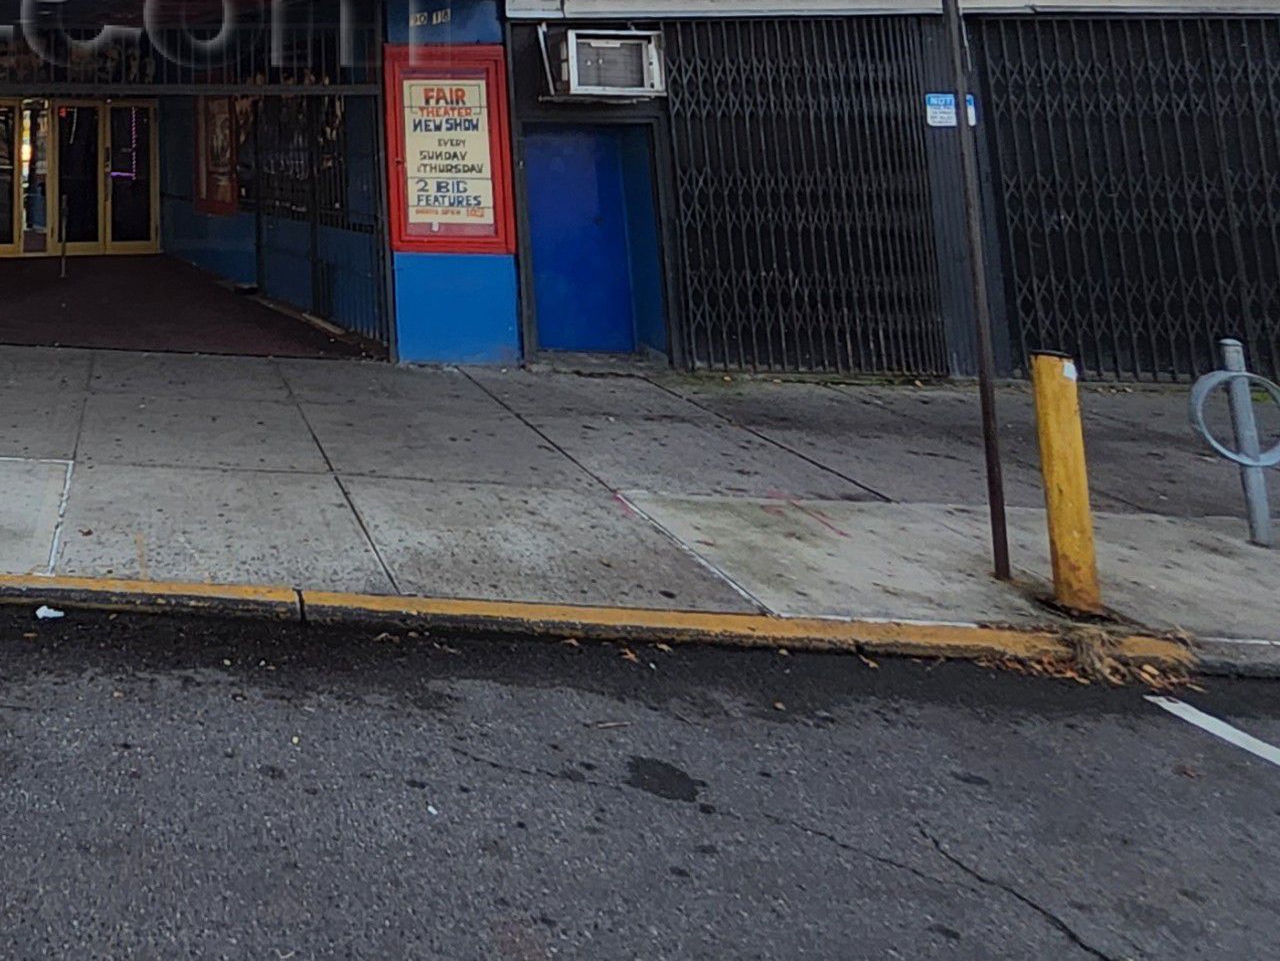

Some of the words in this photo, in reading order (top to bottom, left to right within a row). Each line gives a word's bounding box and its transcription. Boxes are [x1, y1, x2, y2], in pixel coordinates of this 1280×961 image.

[423, 88, 466, 105] FAIR
[419, 107, 472, 117] THEATER
[413, 118, 442, 132] NEW
[445, 118, 479, 131] SHOW
[437, 138, 466, 147] EVERY
[420, 150, 467, 161] SUNDAY
[415, 178, 429, 192] 2
[436, 180, 468, 193] BIG
[416, 194, 482, 207] FEATURES
